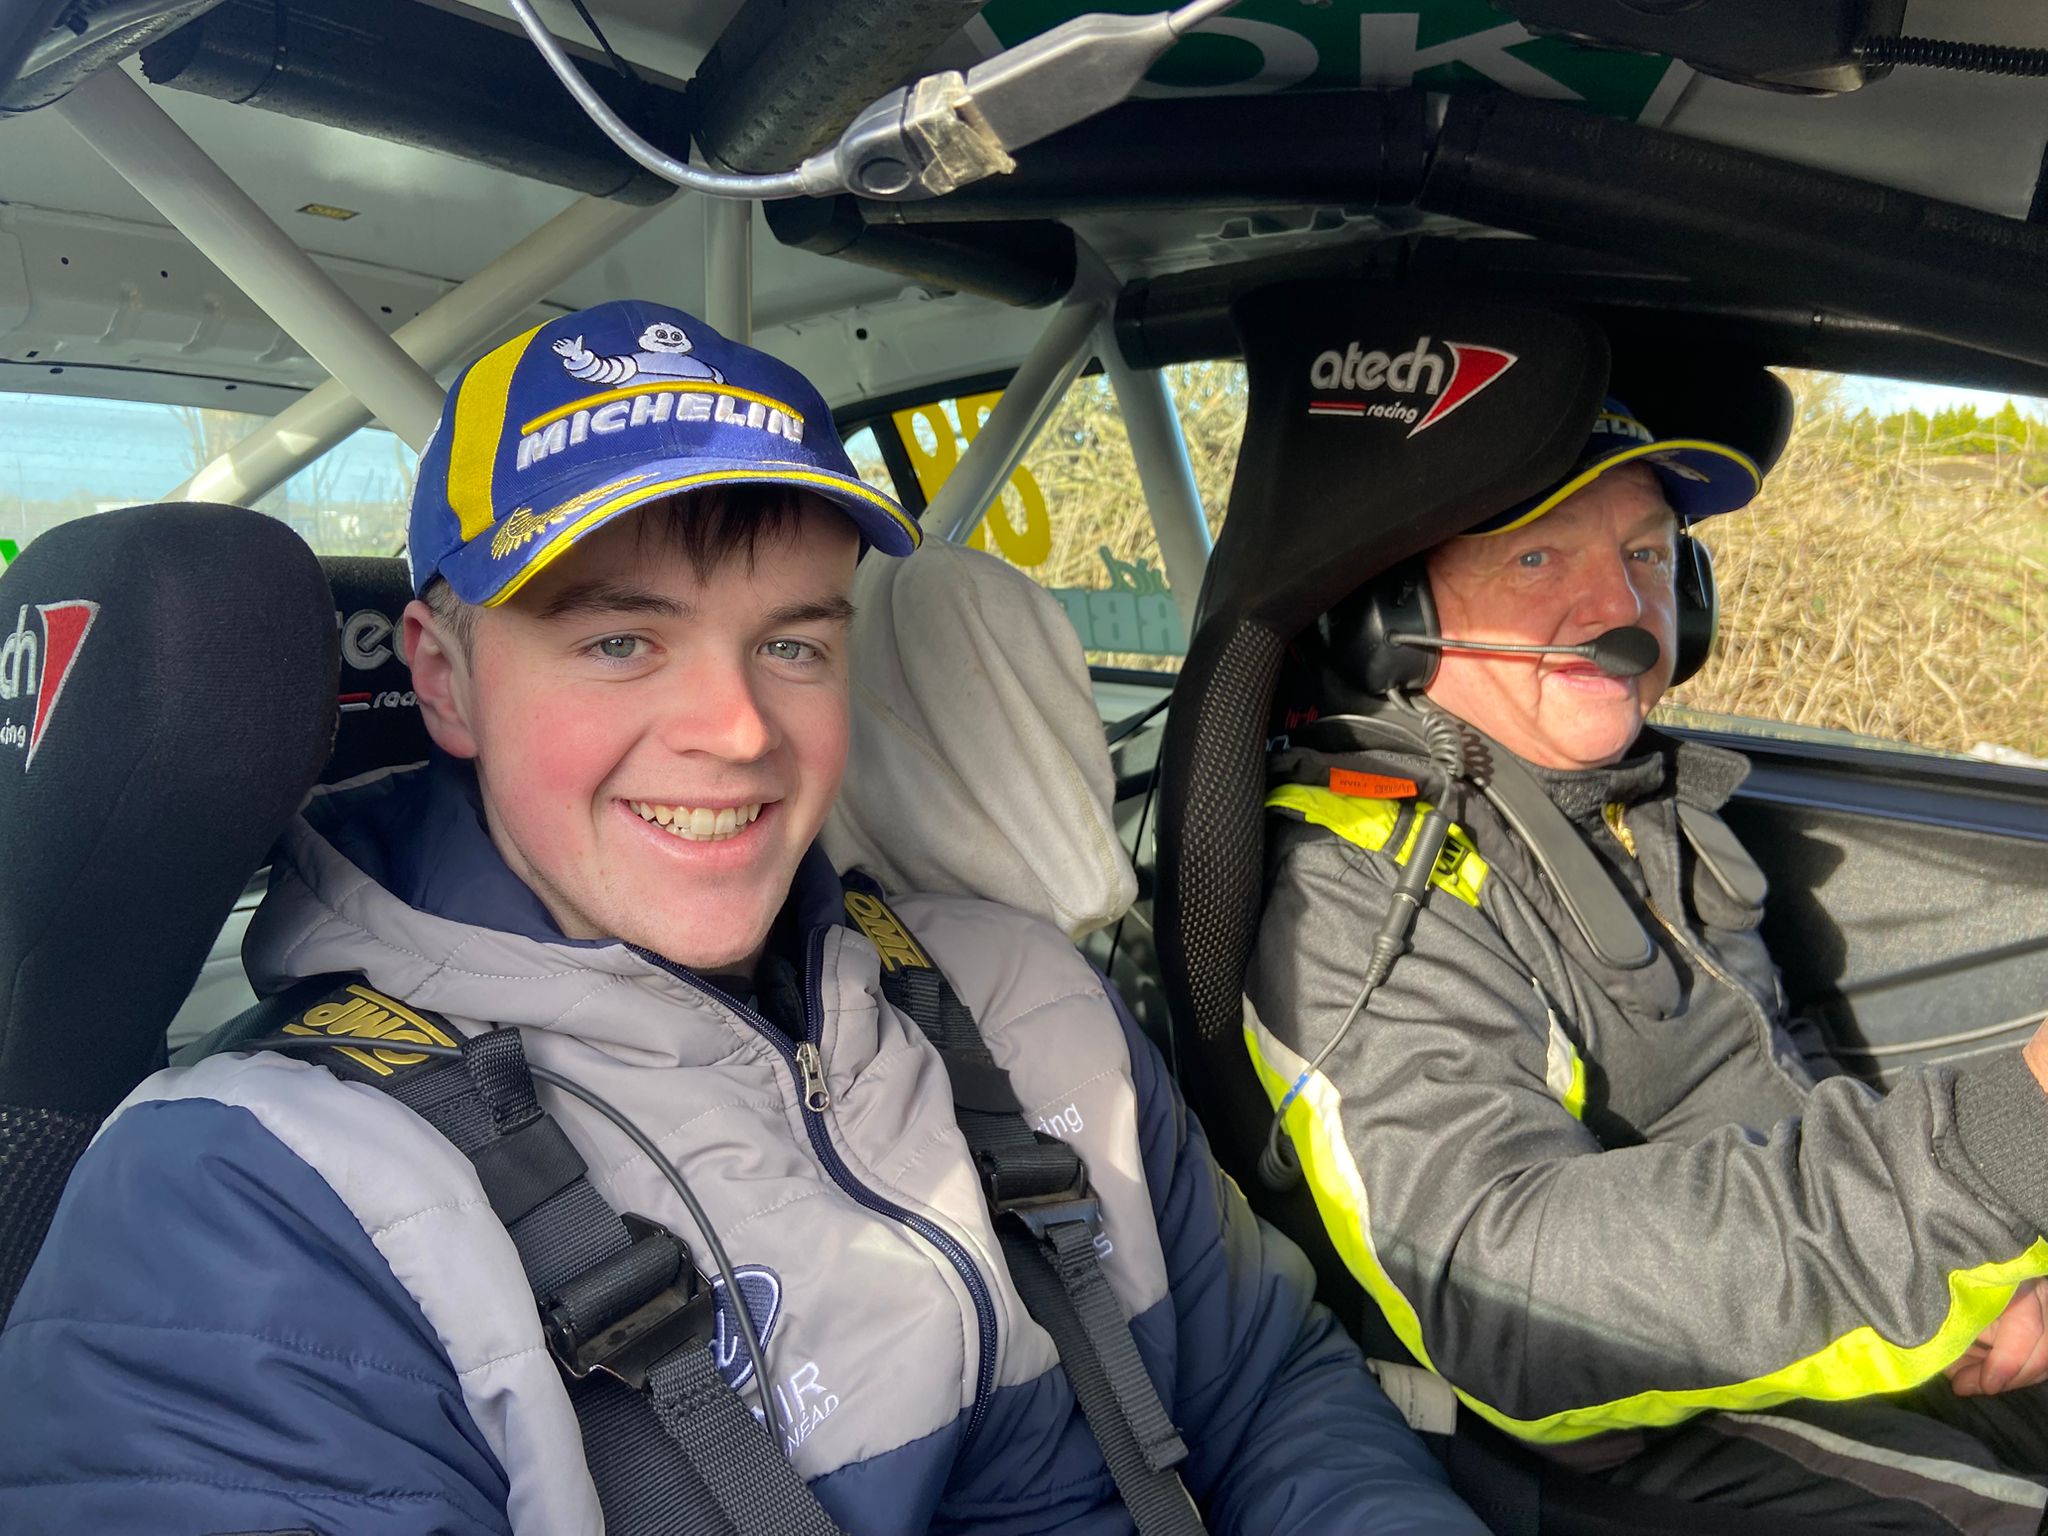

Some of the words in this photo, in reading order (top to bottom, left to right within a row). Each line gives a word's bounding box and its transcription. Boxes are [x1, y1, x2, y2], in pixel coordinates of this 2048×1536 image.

[1309, 336, 1445, 396] atech
[515, 392, 805, 473] MICHELIN
[1367, 402, 1419, 424] racing
[302, 997, 434, 1065] OMP
[1037, 1102, 1085, 1138] ing
